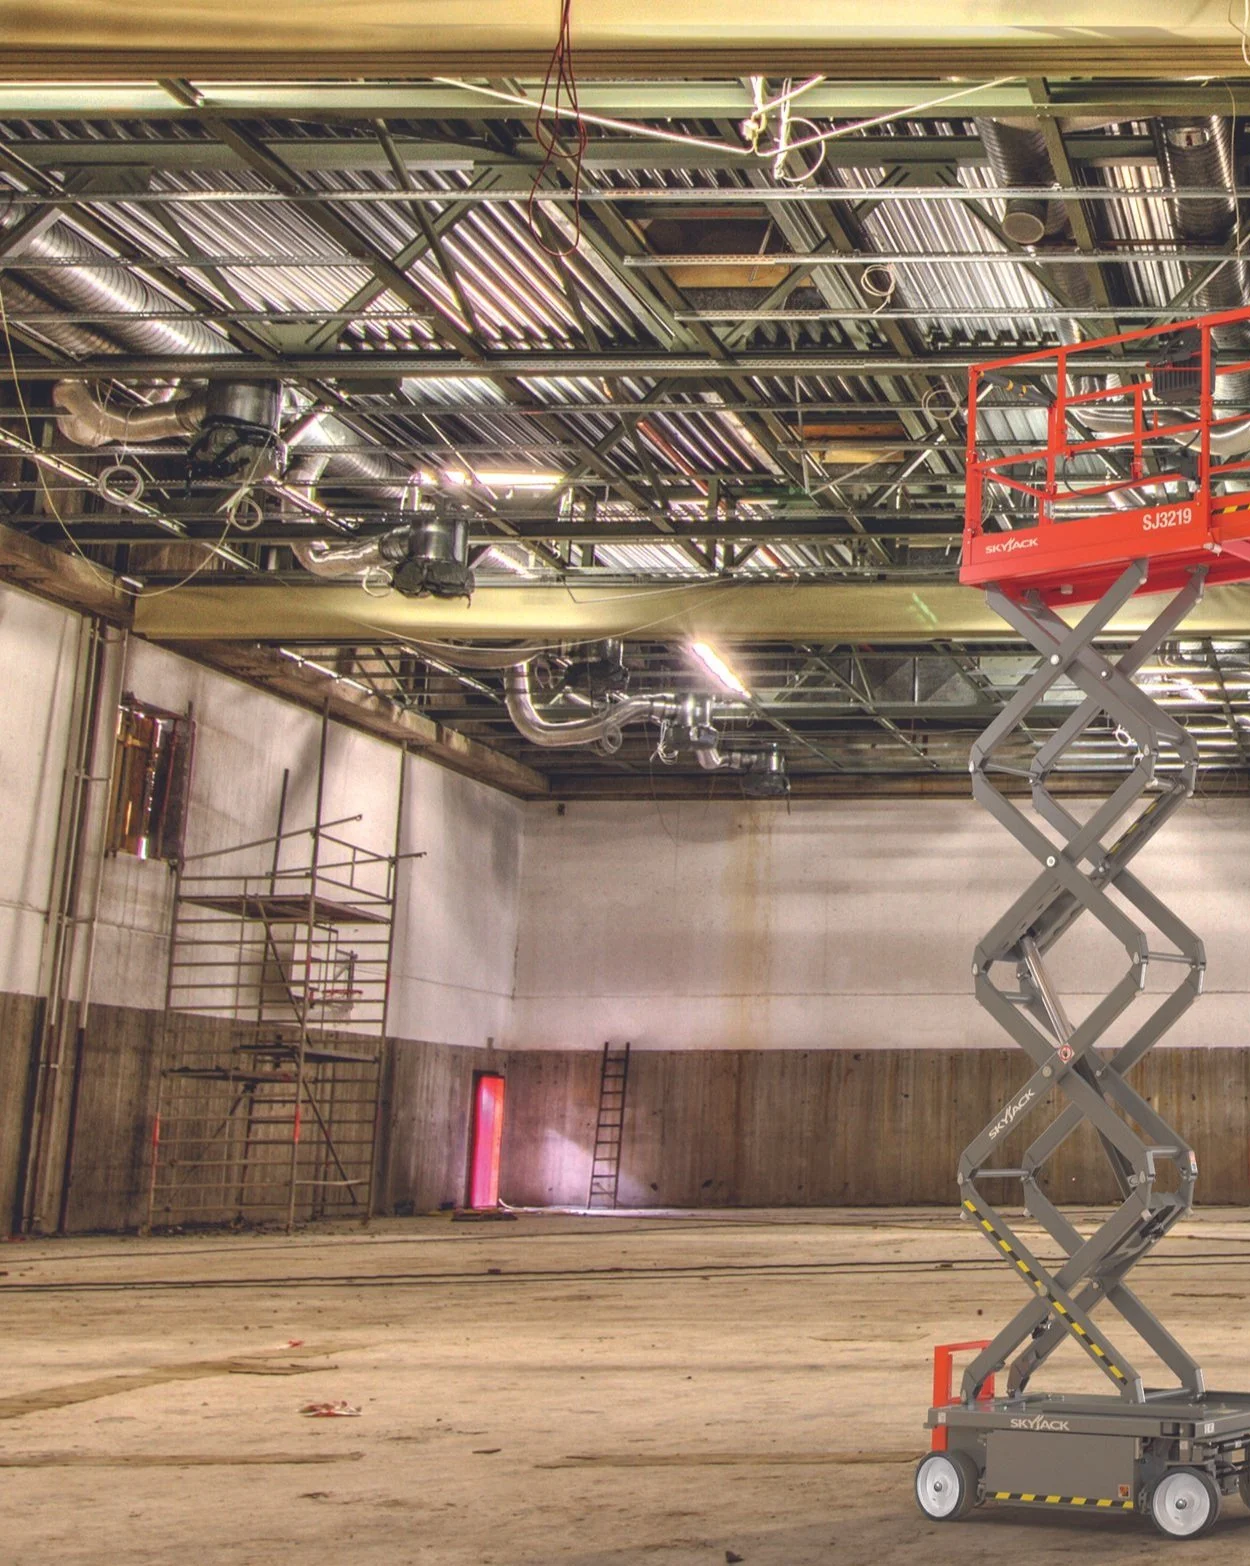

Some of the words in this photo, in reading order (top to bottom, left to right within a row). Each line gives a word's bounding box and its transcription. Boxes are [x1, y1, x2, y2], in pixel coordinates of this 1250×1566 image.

[1142, 507, 1192, 531] SJ3219
[985, 537, 1039, 554] SKYJACK
[988, 1088, 1035, 1140] SKYJACK
[1010, 1414, 1070, 1431] SKYJACK
